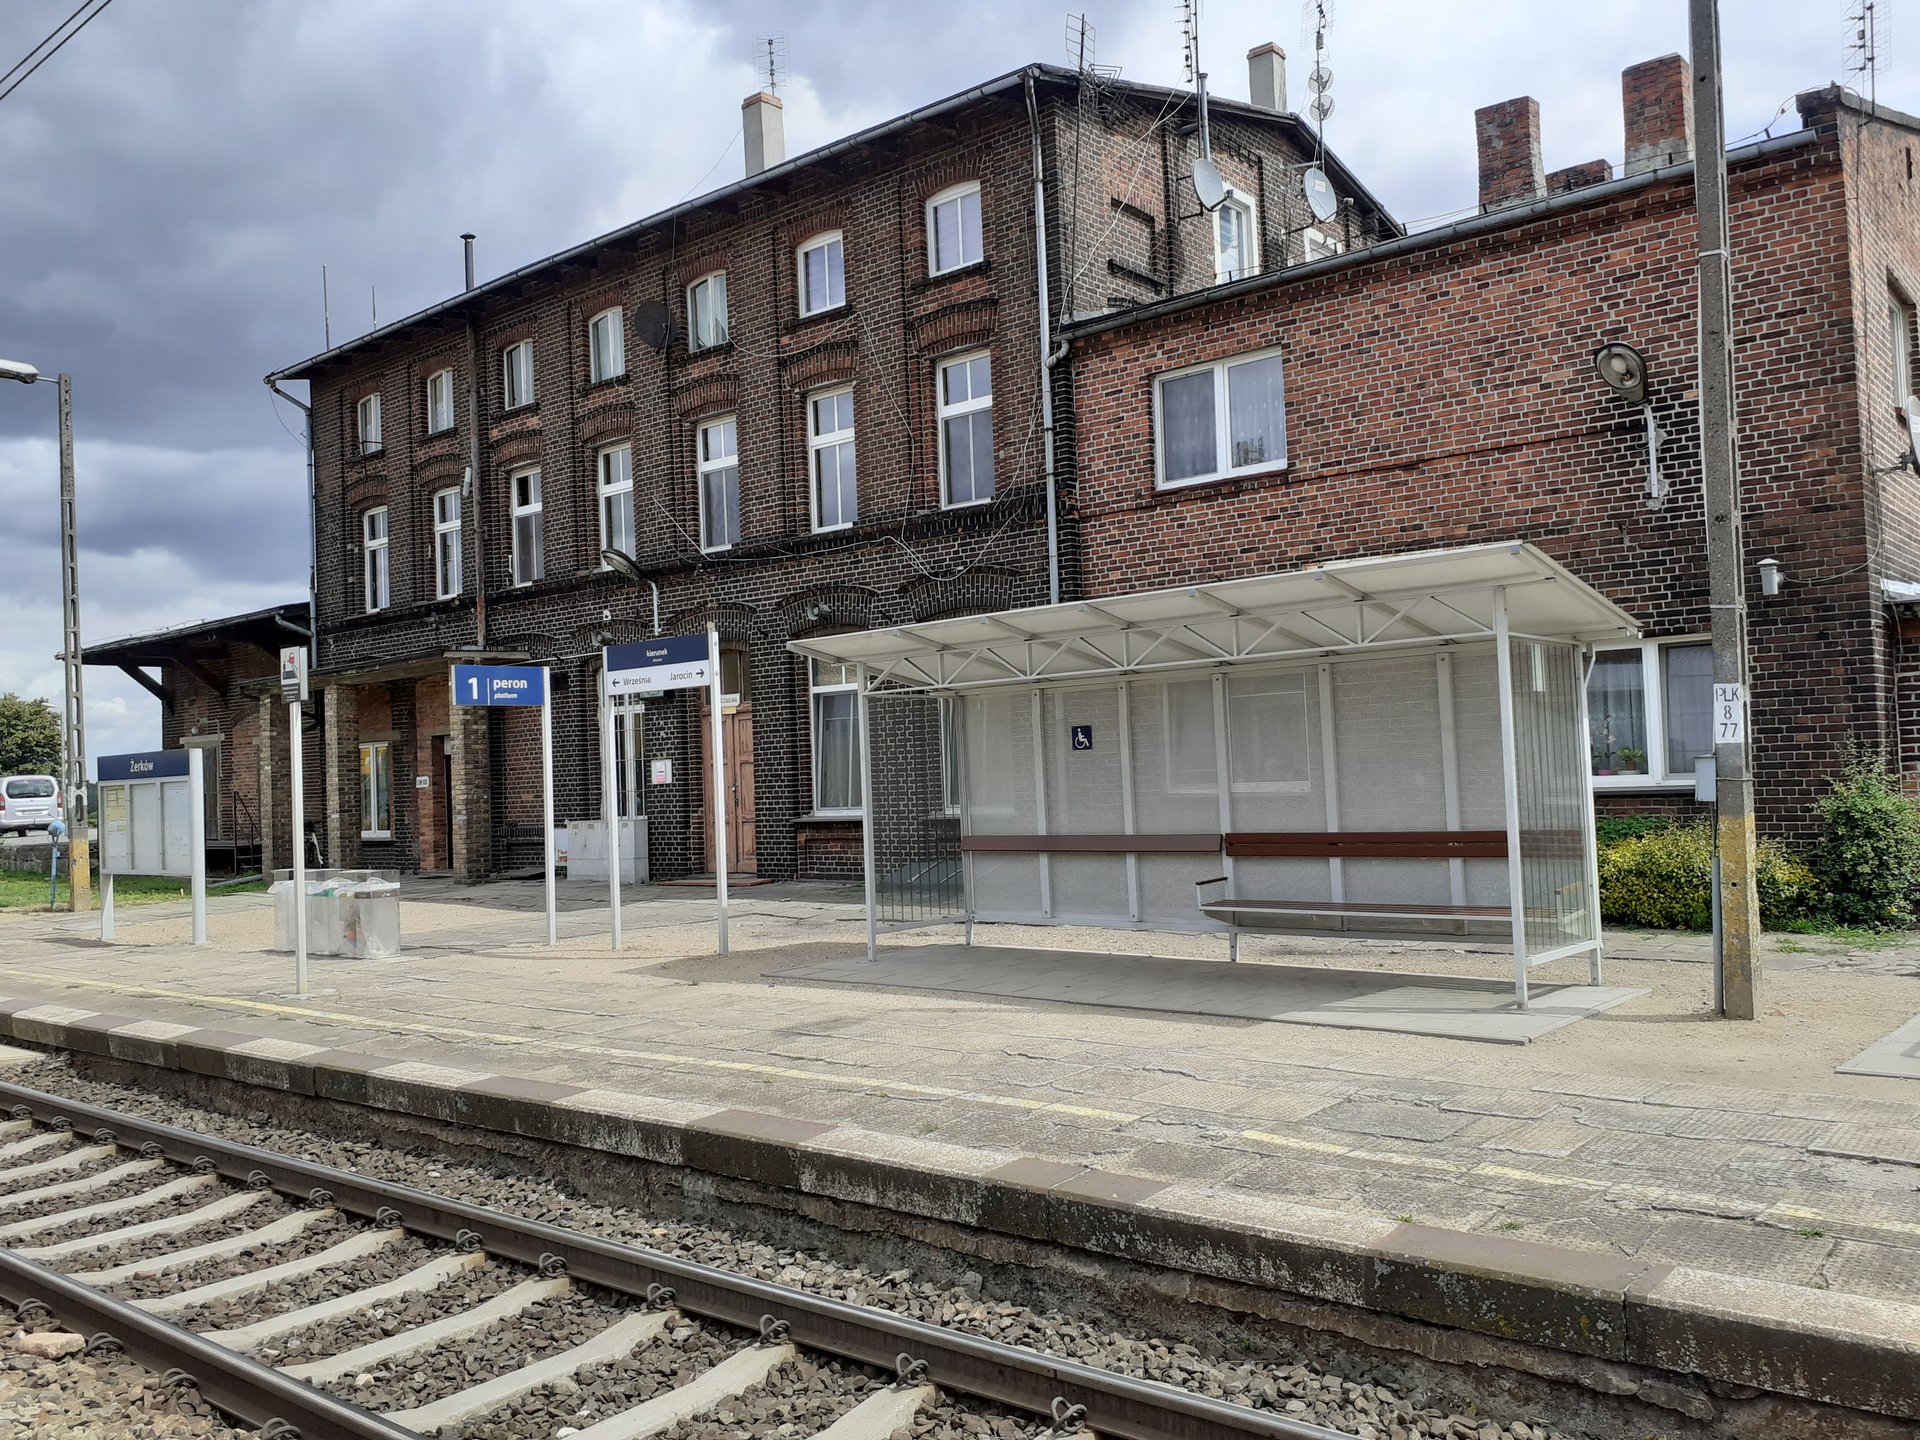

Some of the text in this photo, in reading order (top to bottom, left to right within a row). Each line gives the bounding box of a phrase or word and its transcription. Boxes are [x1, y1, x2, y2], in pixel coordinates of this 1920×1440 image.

[623, 676, 651, 686] Września
[670, 671, 693, 681] Jarocin
[468, 677, 478, 700] 1
[493, 679, 528, 690] peron
[494, 692, 518, 700] platform
[1715, 687, 1739, 702] PLK
[1723, 704, 1733, 720] 8
[1719, 722, 1738, 738] 77
[130, 758, 154, 772] Żerków
